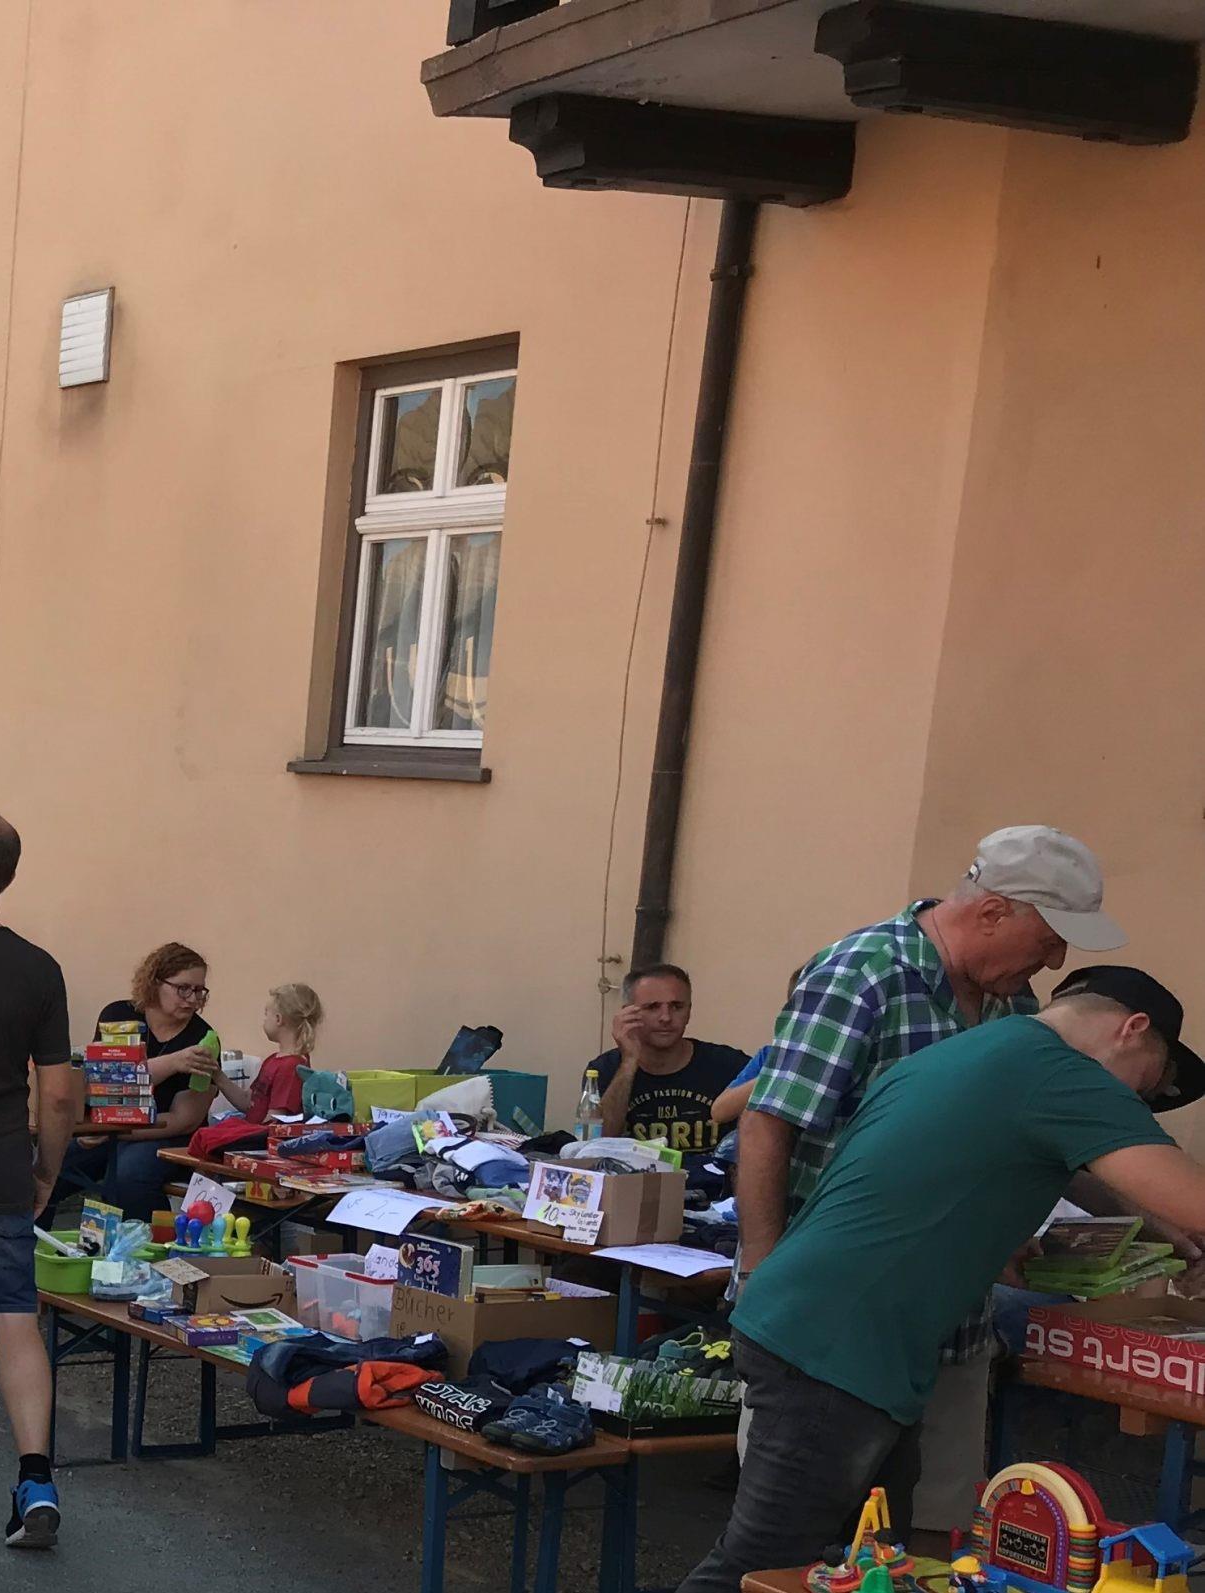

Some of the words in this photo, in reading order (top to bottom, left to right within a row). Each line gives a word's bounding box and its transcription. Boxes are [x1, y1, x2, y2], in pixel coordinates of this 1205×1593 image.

[654, 1088, 693, 1099] FASHION
[695, 1093, 714, 1107] BRA
[626, 1120, 719, 1148] SPRIT
[415, 1254, 441, 1279] 365
[393, 1286, 455, 1325] Bücher
[1025, 1323, 1074, 1358] st
[415, 1394, 474, 1432] WARS
[420, 1382, 492, 1414] STAR
